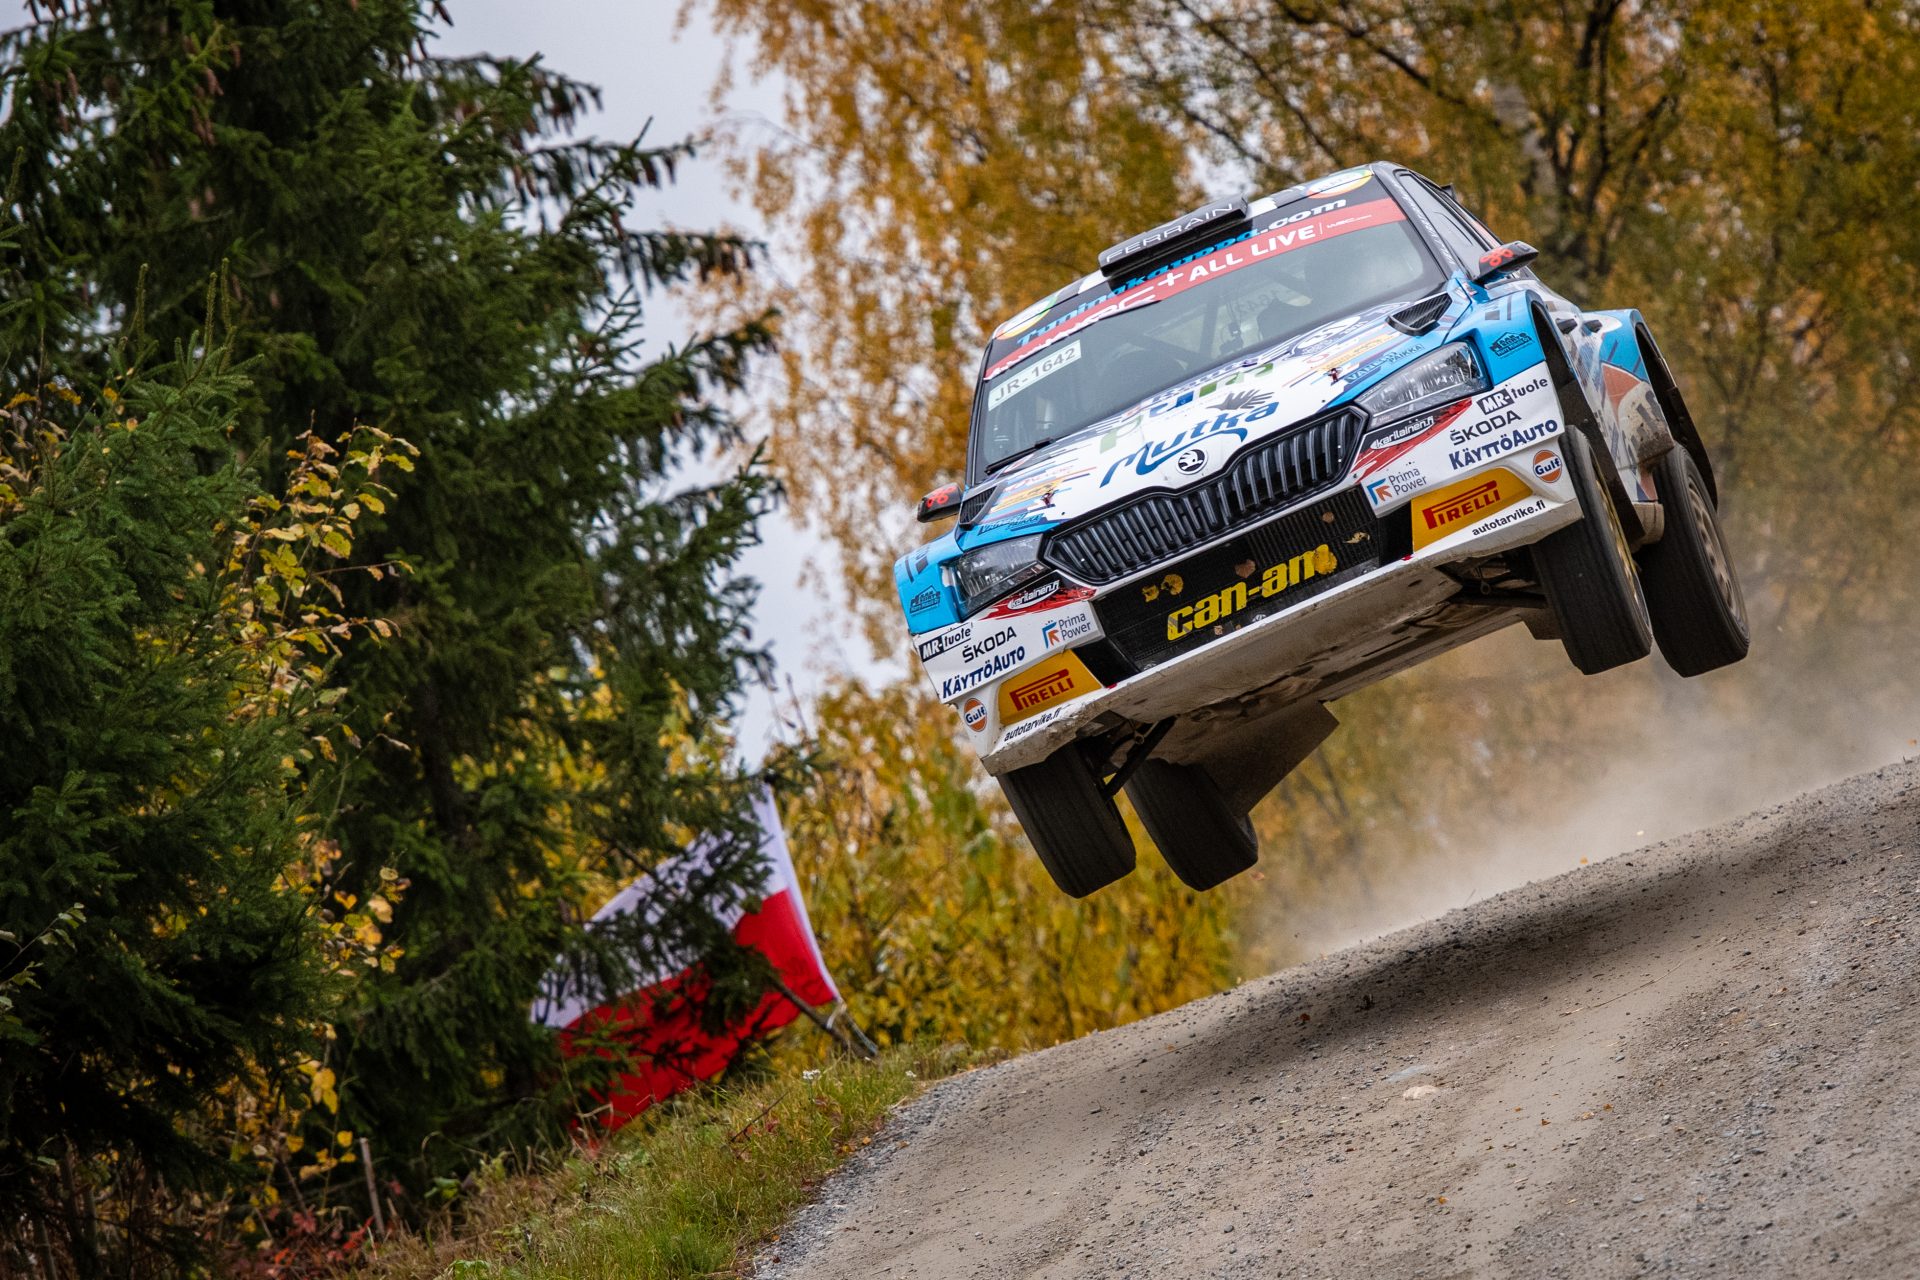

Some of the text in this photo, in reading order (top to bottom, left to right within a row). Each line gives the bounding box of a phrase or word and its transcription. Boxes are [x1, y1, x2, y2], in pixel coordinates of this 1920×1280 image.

[1188, 252, 1243, 282] ALL
[1250, 224, 1316, 256] LIVE
[994, 346, 1077, 402] JR-1642
[1099, 401, 1280, 489] Mutka
[1450, 409, 1522, 446] ŠKODA
[1388, 466, 1421, 486] Prima
[1534, 456, 1562, 476] Gulf
[1393, 476, 1428, 496] Power
[1422, 479, 1500, 530] PIRELLI
[1471, 499, 1547, 537] autotarvike.fi
[1058, 612, 1087, 631] Prima
[1061, 621, 1092, 641] Power
[962, 625, 1018, 664] ŠKODA
[1009, 668, 1075, 712] PIRELLI
[965, 705, 987, 725] Gulf
[1003, 706, 1062, 742] autotarvike.fi
